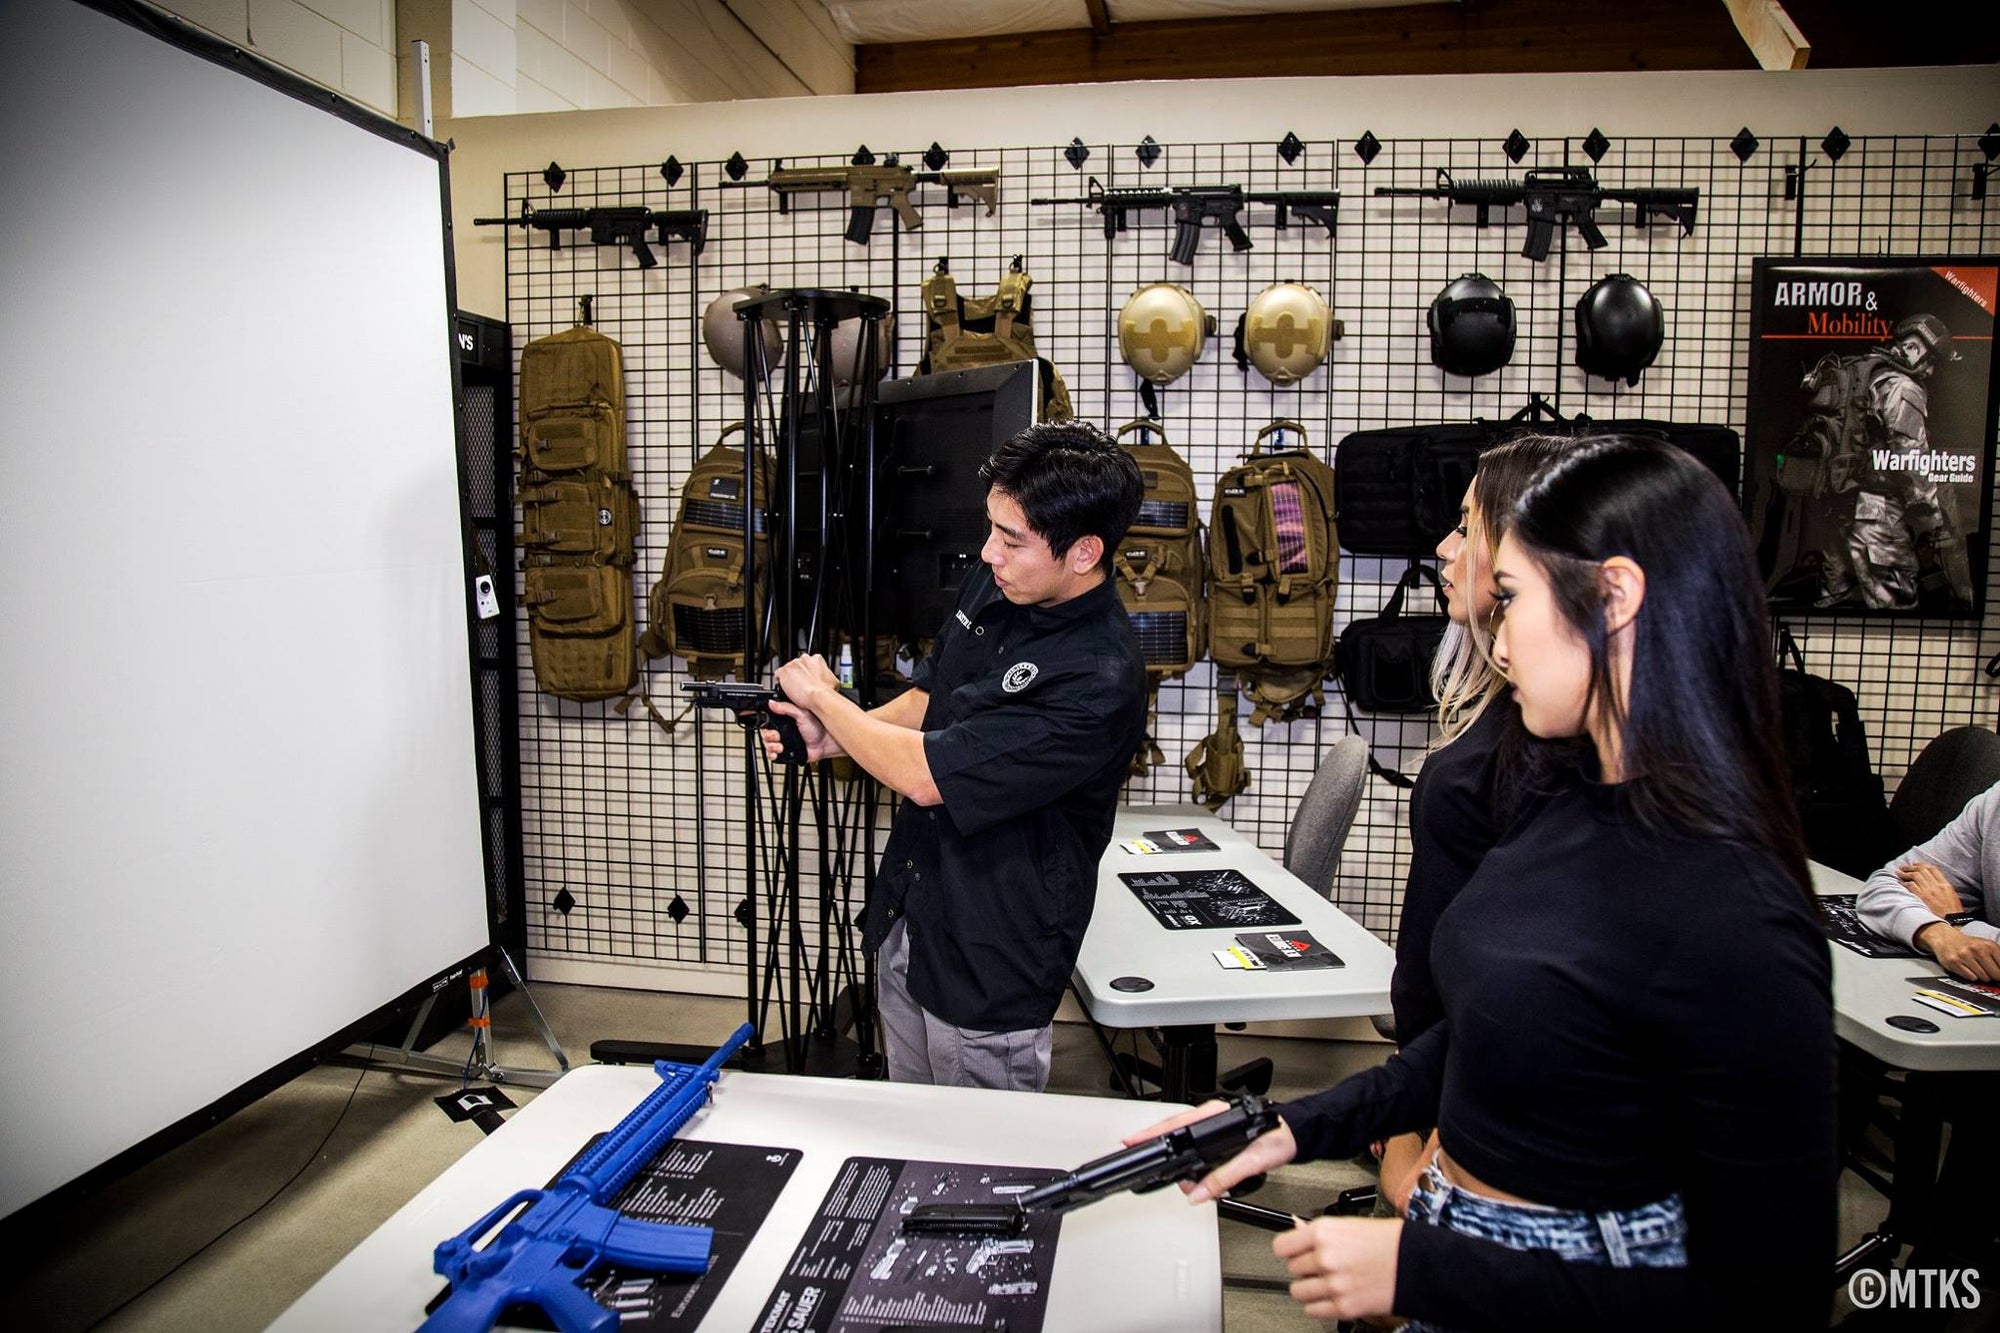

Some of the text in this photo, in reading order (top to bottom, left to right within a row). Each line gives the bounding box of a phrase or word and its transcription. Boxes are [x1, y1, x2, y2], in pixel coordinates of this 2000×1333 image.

[1774, 282, 1878, 311] ARMOR &
[1944, 270, 1988, 308] Warfighters
[1807, 312, 1894, 342] Mobility
[1872, 449, 1976, 476] Warfighters
[1928, 473, 1974, 483] Gear Guide
[787, 1286, 820, 1329] SAUER
